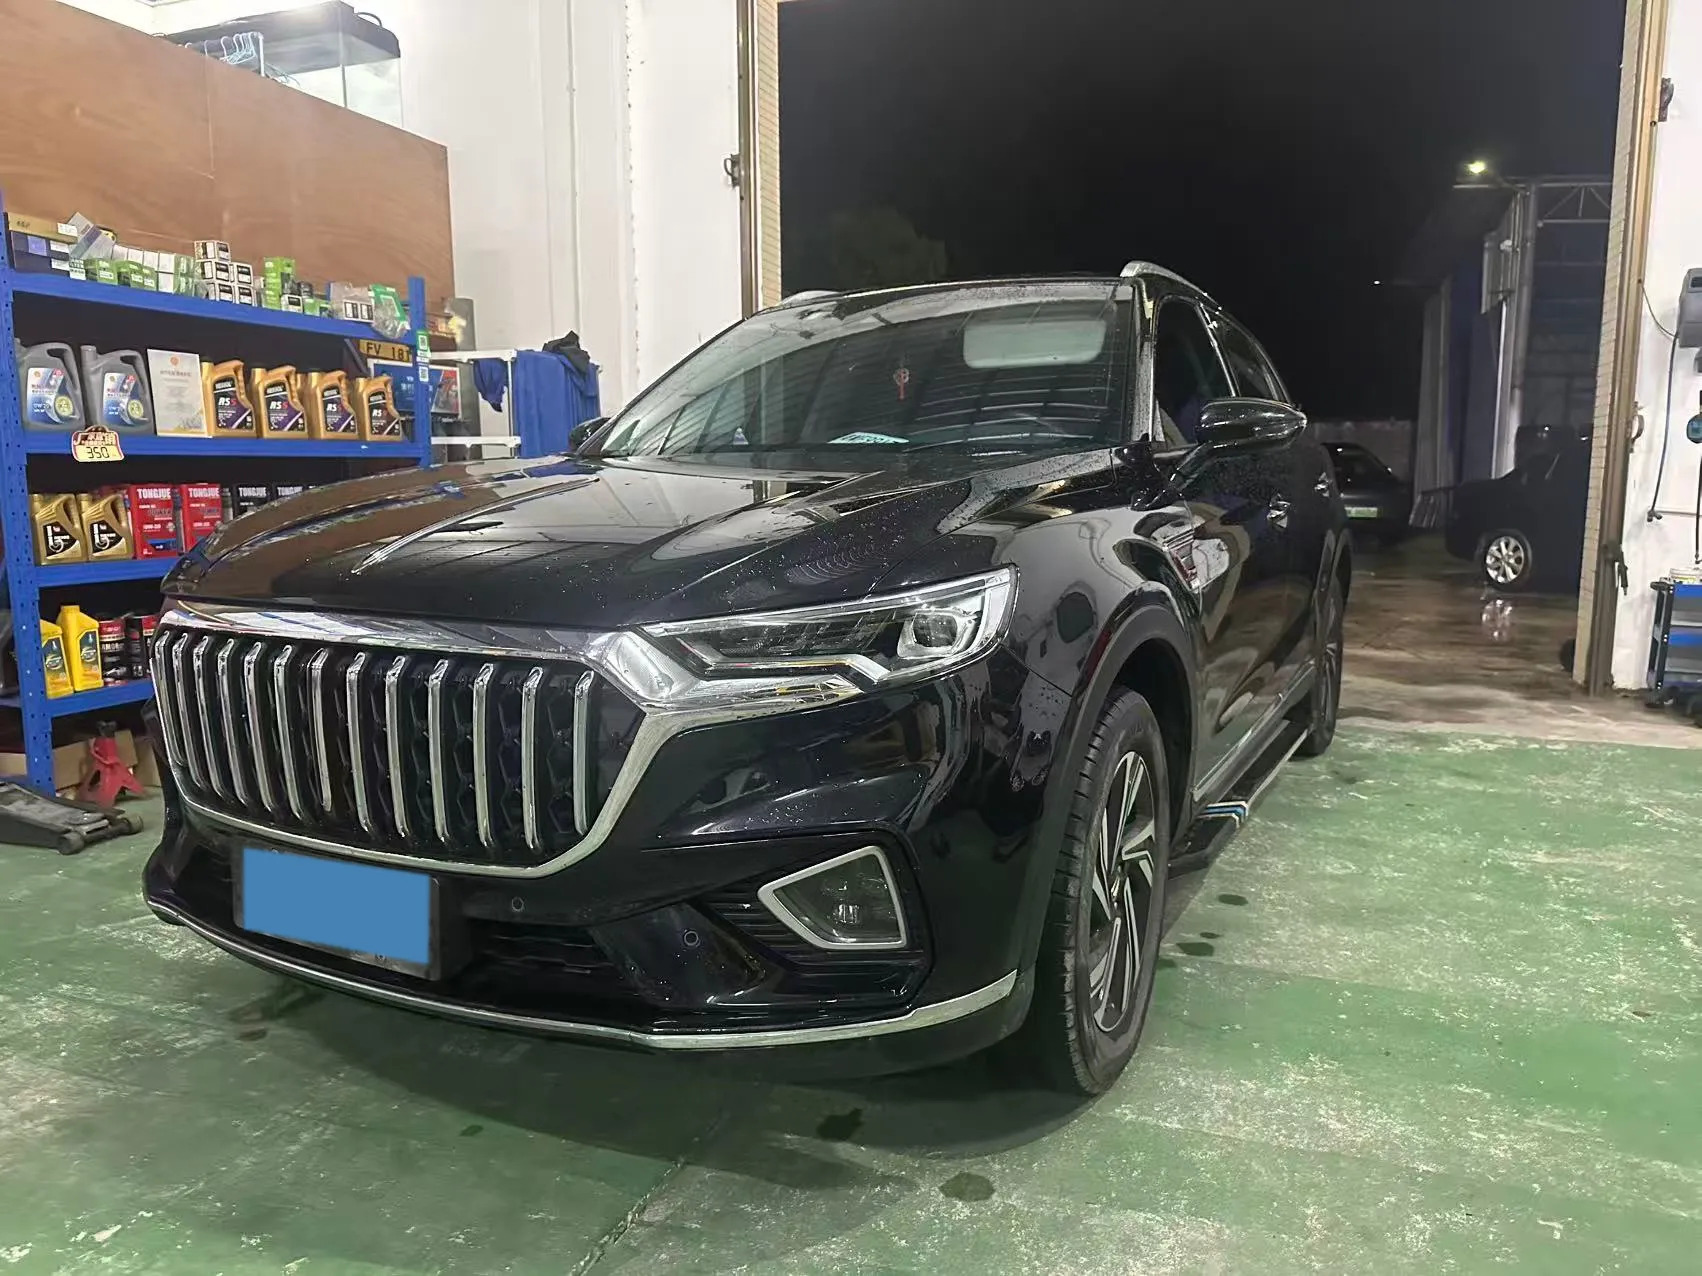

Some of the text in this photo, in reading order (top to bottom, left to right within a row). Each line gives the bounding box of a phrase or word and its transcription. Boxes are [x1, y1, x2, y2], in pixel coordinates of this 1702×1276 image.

[366, 342, 381, 355] FV
[86, 446, 110, 459] 350
[137, 487, 171, 499] TONGJUE
[188, 487, 220, 498] TONGJUE
